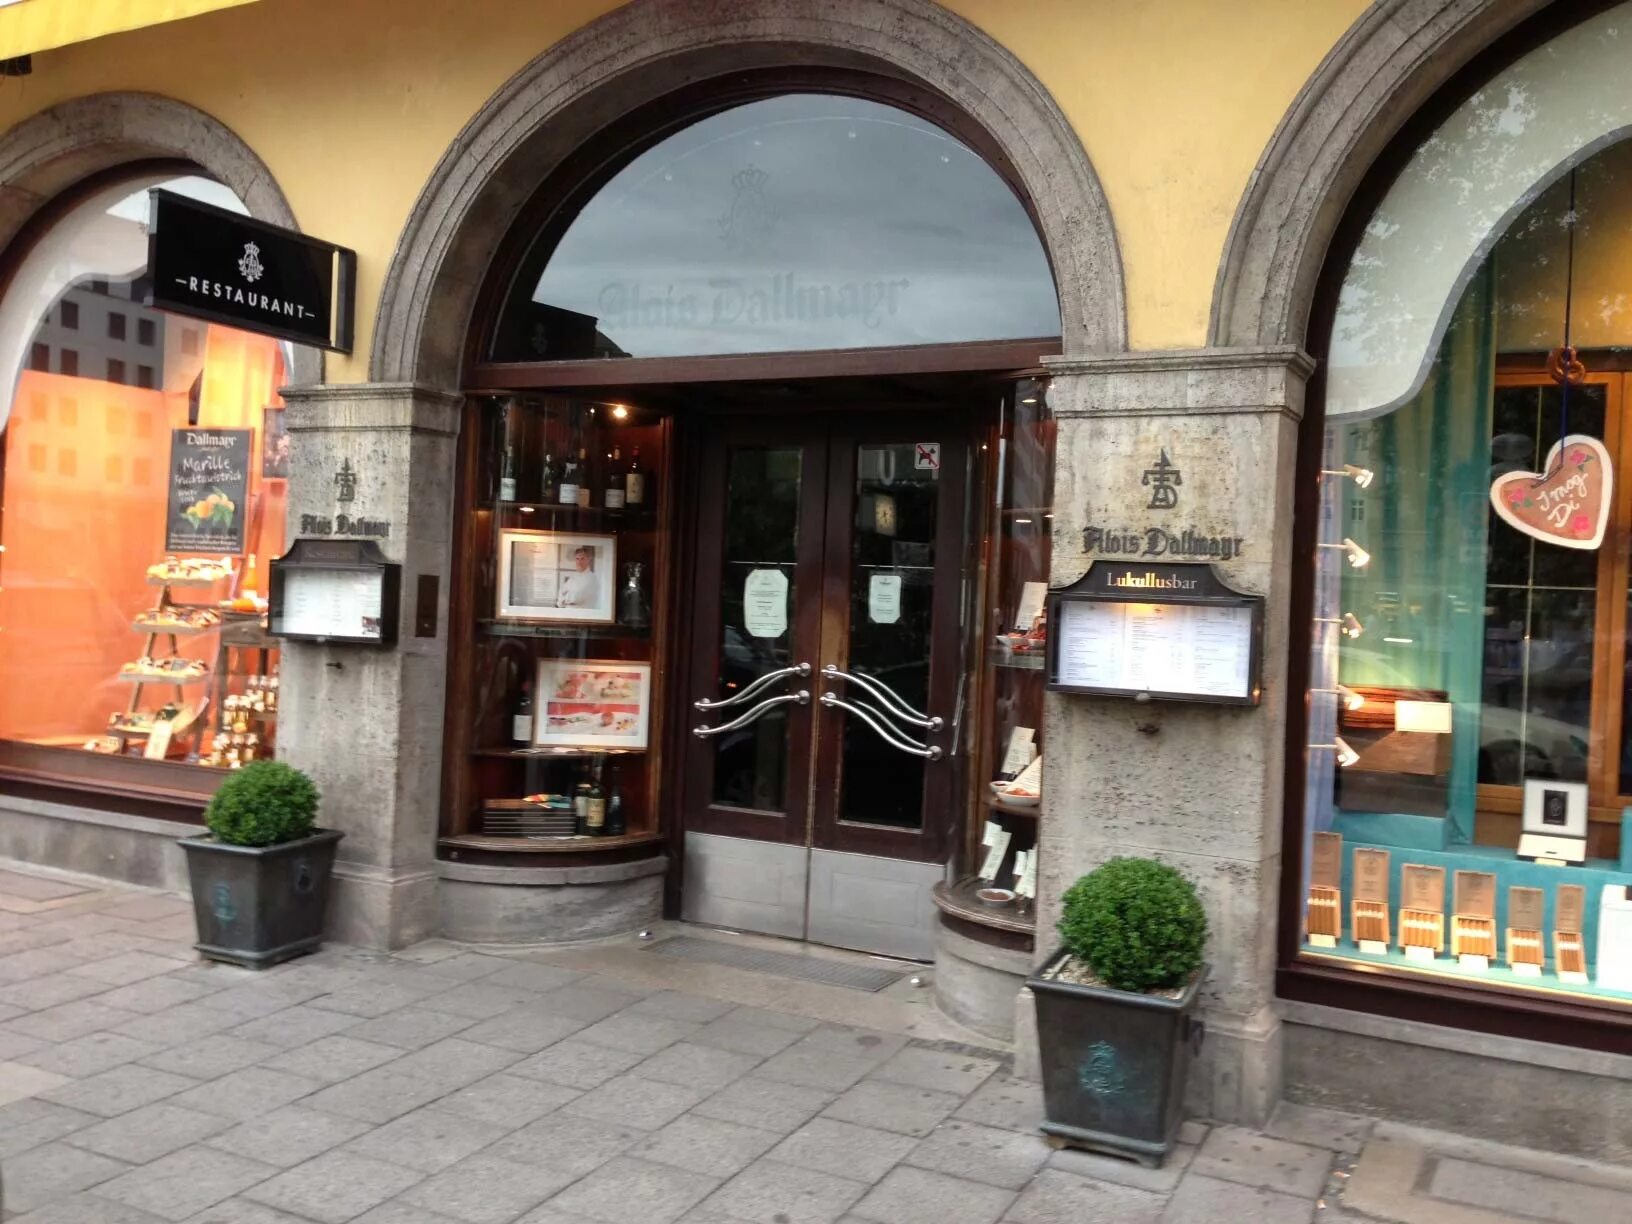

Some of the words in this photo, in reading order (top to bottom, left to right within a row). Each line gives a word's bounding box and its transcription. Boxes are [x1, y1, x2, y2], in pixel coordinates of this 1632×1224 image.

[189, 276, 304, 319] RESTAURANT
[708, 271, 911, 329] Dallmayr
[186, 432, 238, 449] Dallmayr
[183, 455, 231, 472] Marille
[1547, 494, 1580, 528] Di
[1082, 525, 1140, 554] Alois
[1141, 527, 1244, 560] Dallmayr
[1106, 571, 1198, 590] Lukullusbar
